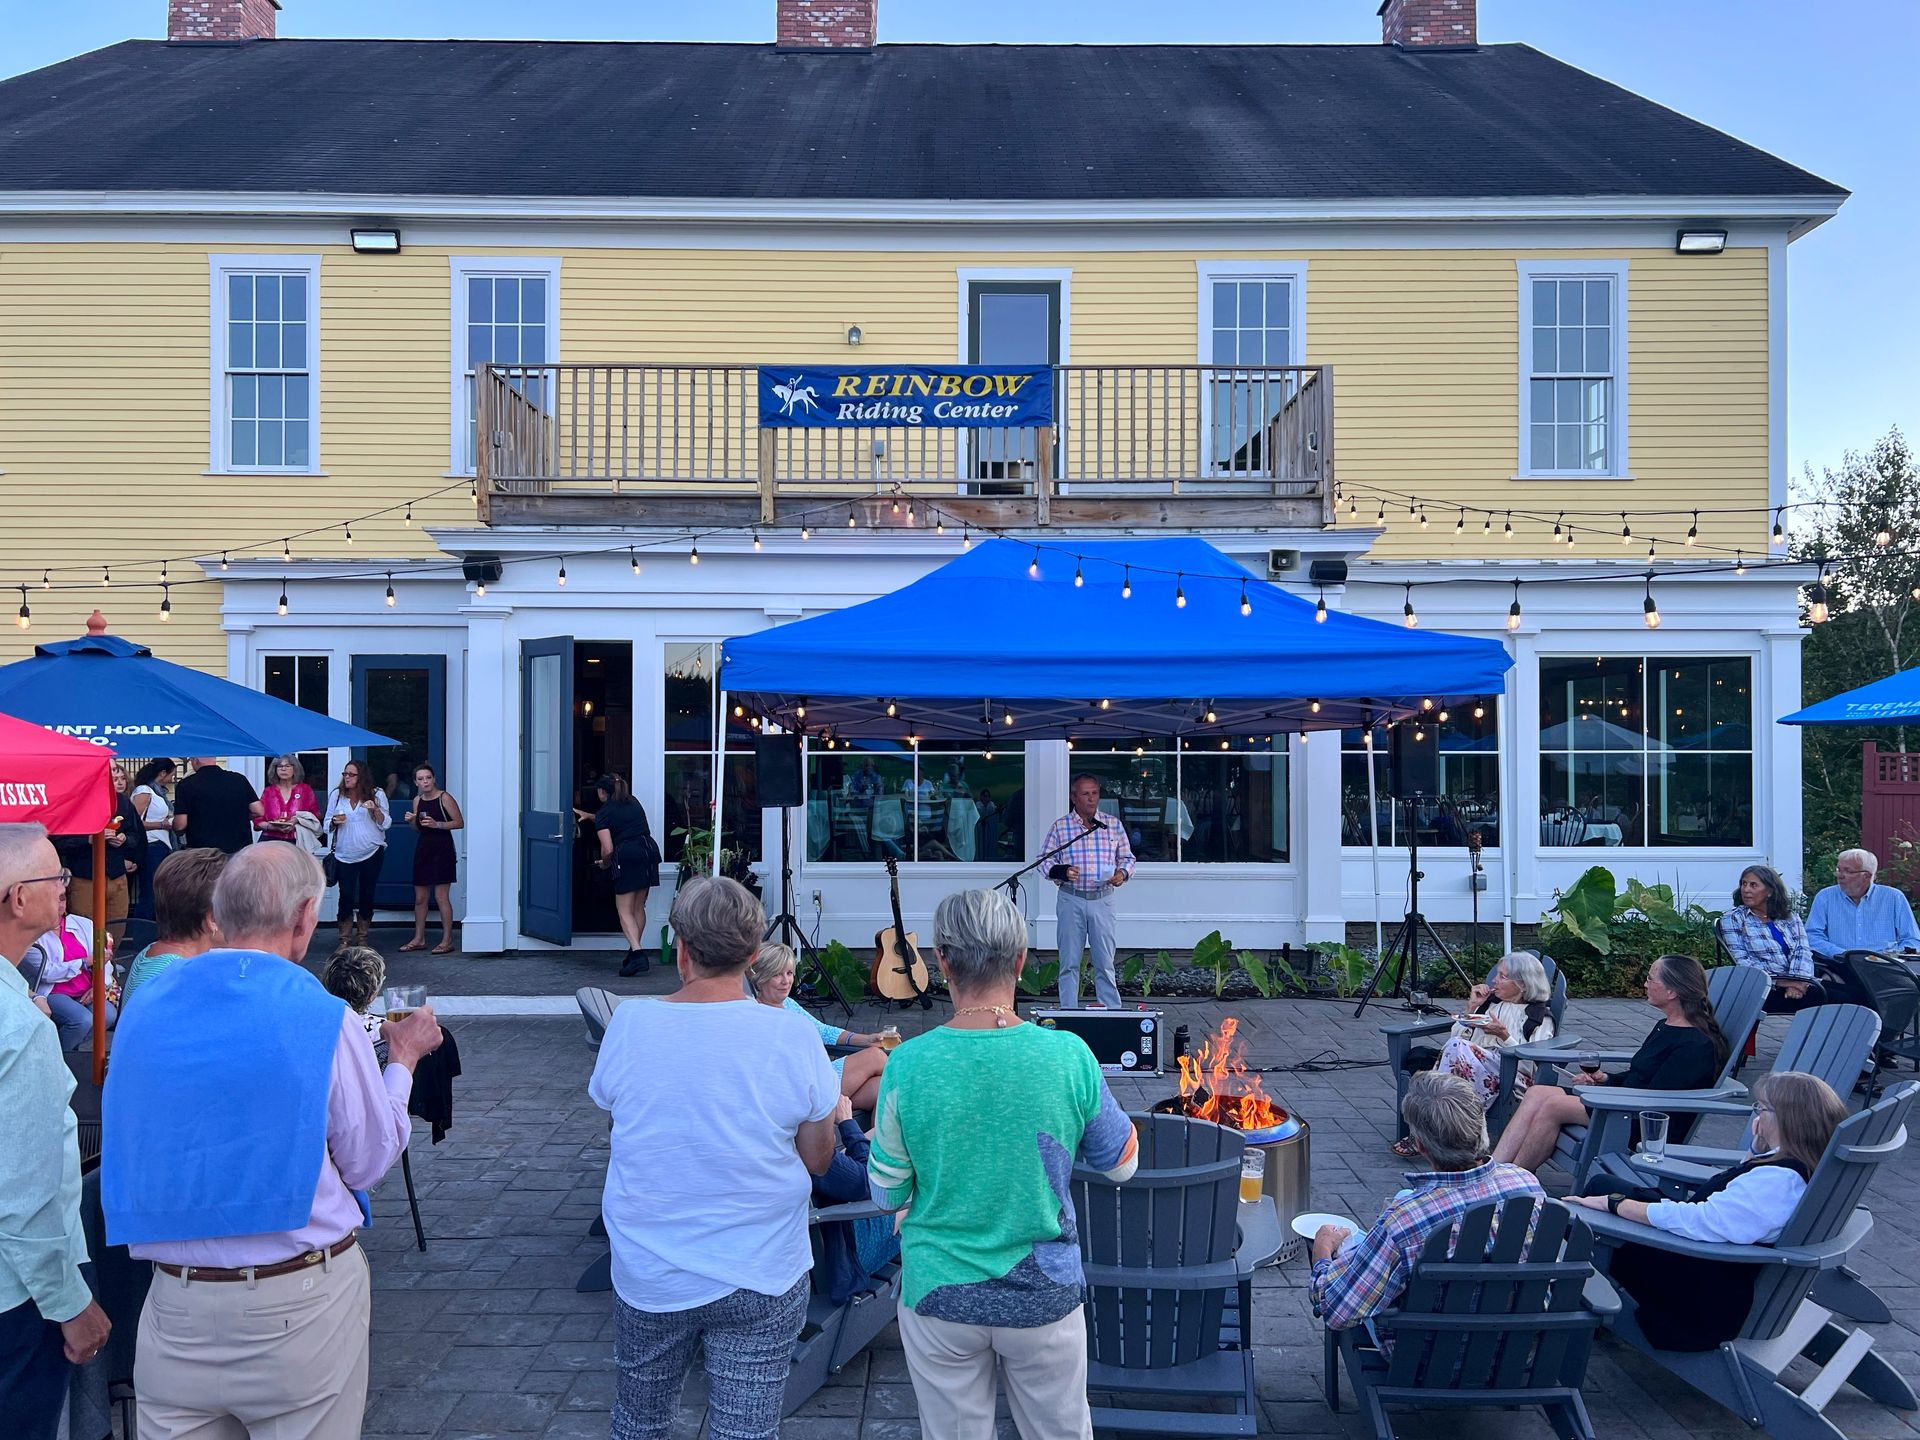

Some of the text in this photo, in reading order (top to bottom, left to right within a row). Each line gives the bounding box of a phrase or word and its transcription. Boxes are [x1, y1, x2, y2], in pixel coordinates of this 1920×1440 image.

[832, 375, 1032, 397] REINBOW
[836, 401, 1019, 423] Riding Center
[104, 725, 181, 735] HOLLY
